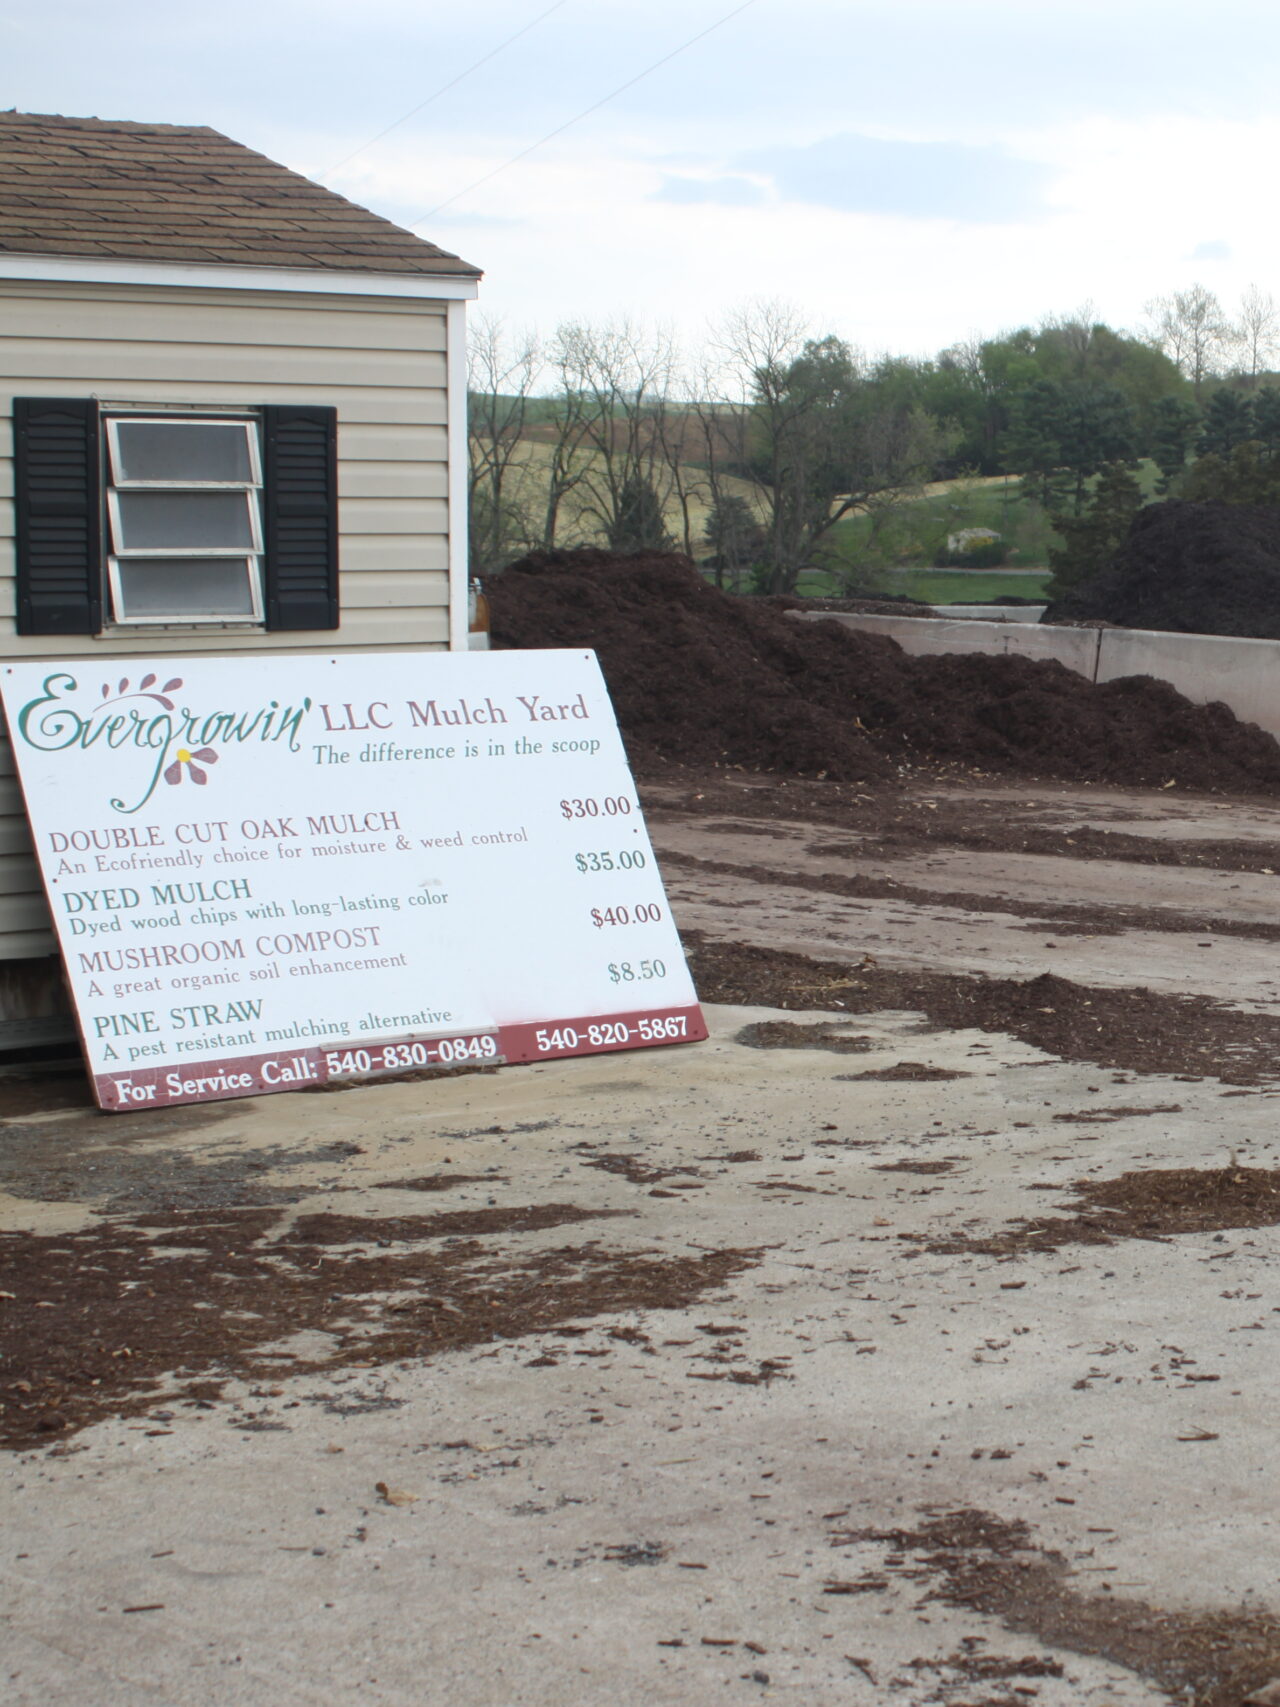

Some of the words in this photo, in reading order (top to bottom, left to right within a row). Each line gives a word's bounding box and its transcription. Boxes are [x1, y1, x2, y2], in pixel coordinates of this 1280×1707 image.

[319, 702, 393, 732] LLC
[406, 699, 508, 727] Mulch
[516, 694, 590, 723] Yard
[312, 745, 350, 765] The
[359, 743, 456, 763] difference
[465, 740, 479, 758] is
[488, 739, 506, 757] in
[514, 736, 544, 755] the
[551, 738, 601, 755] scoop
[559, 796, 631, 821] $30.00
[48, 826, 165, 853] DOUBLE
[174, 821, 229, 844] CUT
[240, 817, 298, 840] OAK
[305, 811, 401, 836] MULCH
[57, 858, 87, 876] An
[213, 846, 270, 864] choice
[277, 843, 302, 860] for
[311, 839, 387, 857] moisture
[395, 834, 411, 851] &
[420, 831, 464, 849] weed
[471, 827, 529, 846] control
[575, 849, 646, 873] $35.00
[62, 887, 141, 913] DYED
[151, 878, 253, 906] MULCH
[69, 917, 122, 938] Dyed
[131, 913, 181, 930] wood
[190, 908, 238, 927] chips
[245, 903, 286, 921] with
[292, 894, 401, 917] long-lasting
[408, 889, 449, 907] color
[590, 903, 662, 929] $40.00
[78, 938, 246, 973] MUSHROOM
[255, 926, 383, 956] COMPOST
[87, 980, 104, 997] A
[113, 977, 162, 999] great
[171, 968, 241, 990] organic
[249, 963, 281, 981] soil
[289, 952, 408, 977] enhancement
[607, 959, 667, 984] $8.50
[93, 1011, 160, 1038] PINE
[170, 999, 263, 1030] STRAW
[102, 1045, 120, 1061] A
[128, 1041, 168, 1062] pest
[175, 1029, 257, 1053] resistant
[265, 1019, 350, 1042] mulching
[359, 1008, 452, 1031] alternative
[535, 1015, 688, 1051] 540-820-5867
[113, 1078, 156, 1103] For
[165, 1068, 252, 1097] Service
[260, 1057, 318, 1085] Call:
[326, 1036, 497, 1075] 540-830-0849
